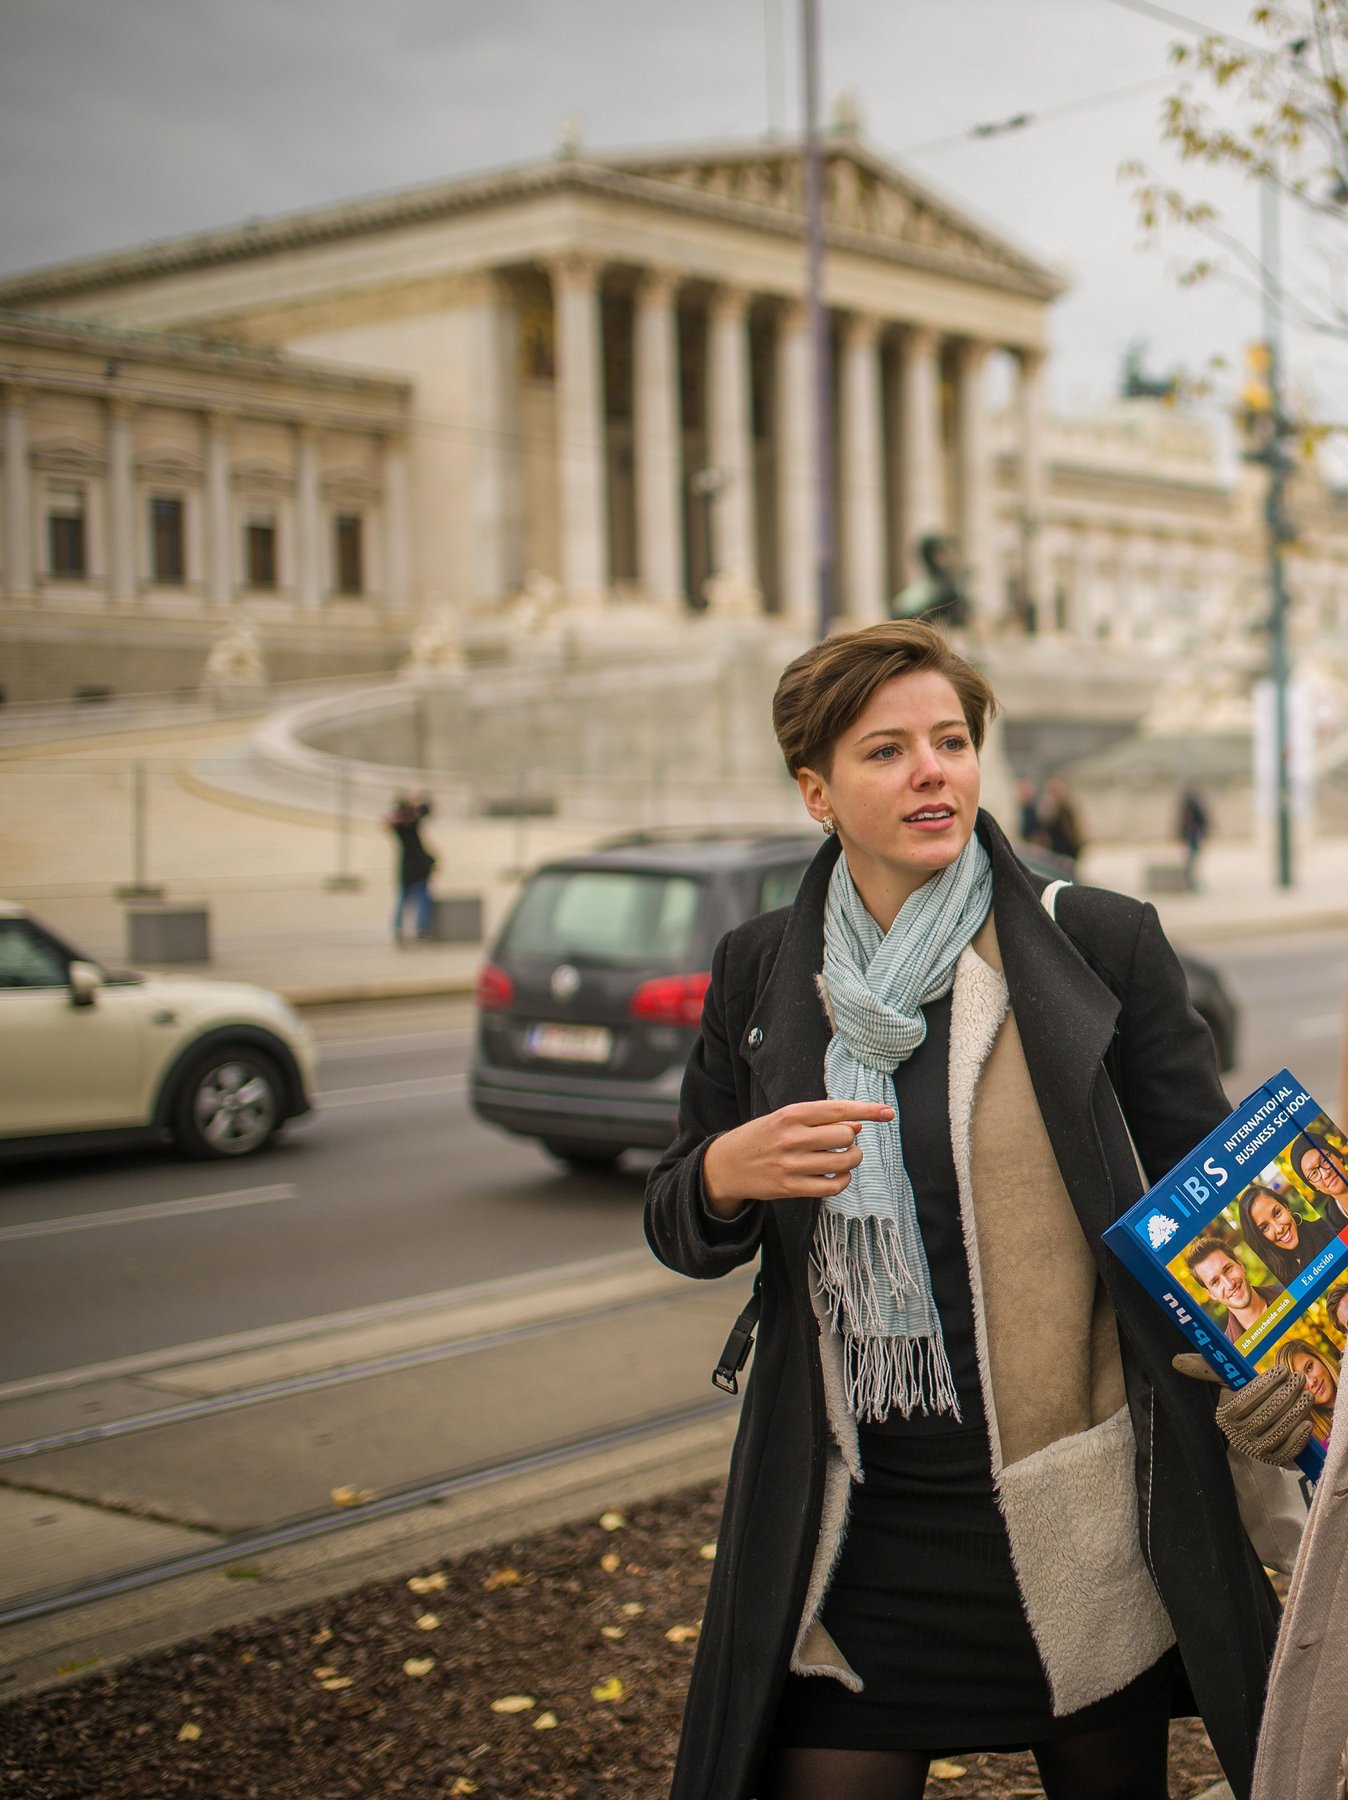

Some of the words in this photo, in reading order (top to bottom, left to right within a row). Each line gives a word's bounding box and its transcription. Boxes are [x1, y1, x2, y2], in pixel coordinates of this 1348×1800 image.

[1223, 1086, 1293, 1153] INTERNATIONAL
[1234, 1123, 1276, 1166] BUSINESS
[1273, 1092, 1311, 1128] SCHOOL
[1300, 1273, 1314, 1287] Eu
[1312, 1252, 1335, 1277] decido
[1241, 1334, 1252, 1350] Ich
[1250, 1311, 1279, 1341] entscheide
[1276, 1297, 1291, 1317] mich
